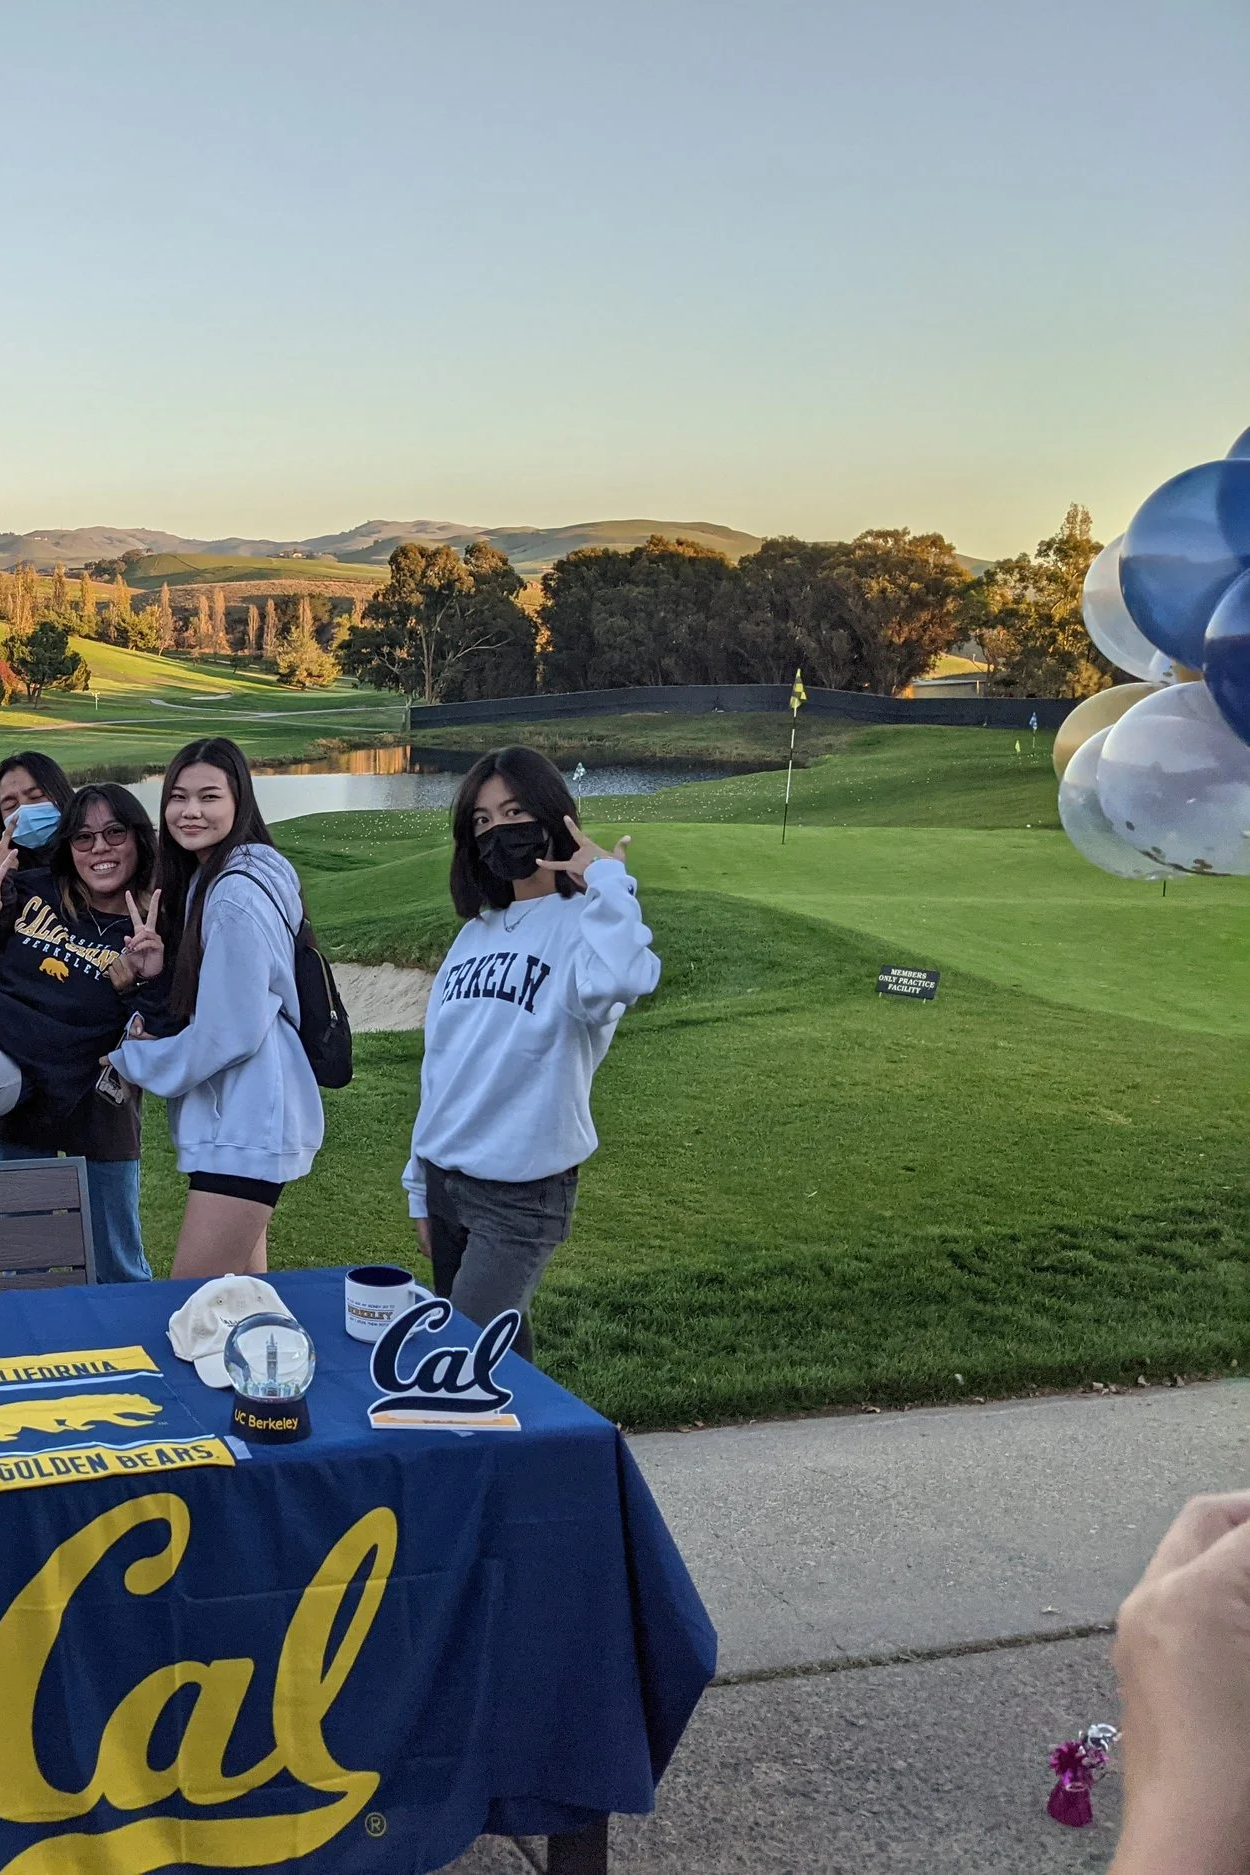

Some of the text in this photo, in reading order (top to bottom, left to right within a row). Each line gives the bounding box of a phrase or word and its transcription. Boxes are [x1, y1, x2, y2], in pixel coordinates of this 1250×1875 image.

[22, 937, 102, 981] BERKELEY
[878, 975, 935, 989] ONLY PRACTICE
[890, 969, 927, 979] MEMBERS
[887, 984, 921, 994] FACILITY
[373, 1300, 519, 1395] Cal
[234, 1408, 299, 1431] UC Berkeley
[114, 1444, 214, 1471] BEARS
